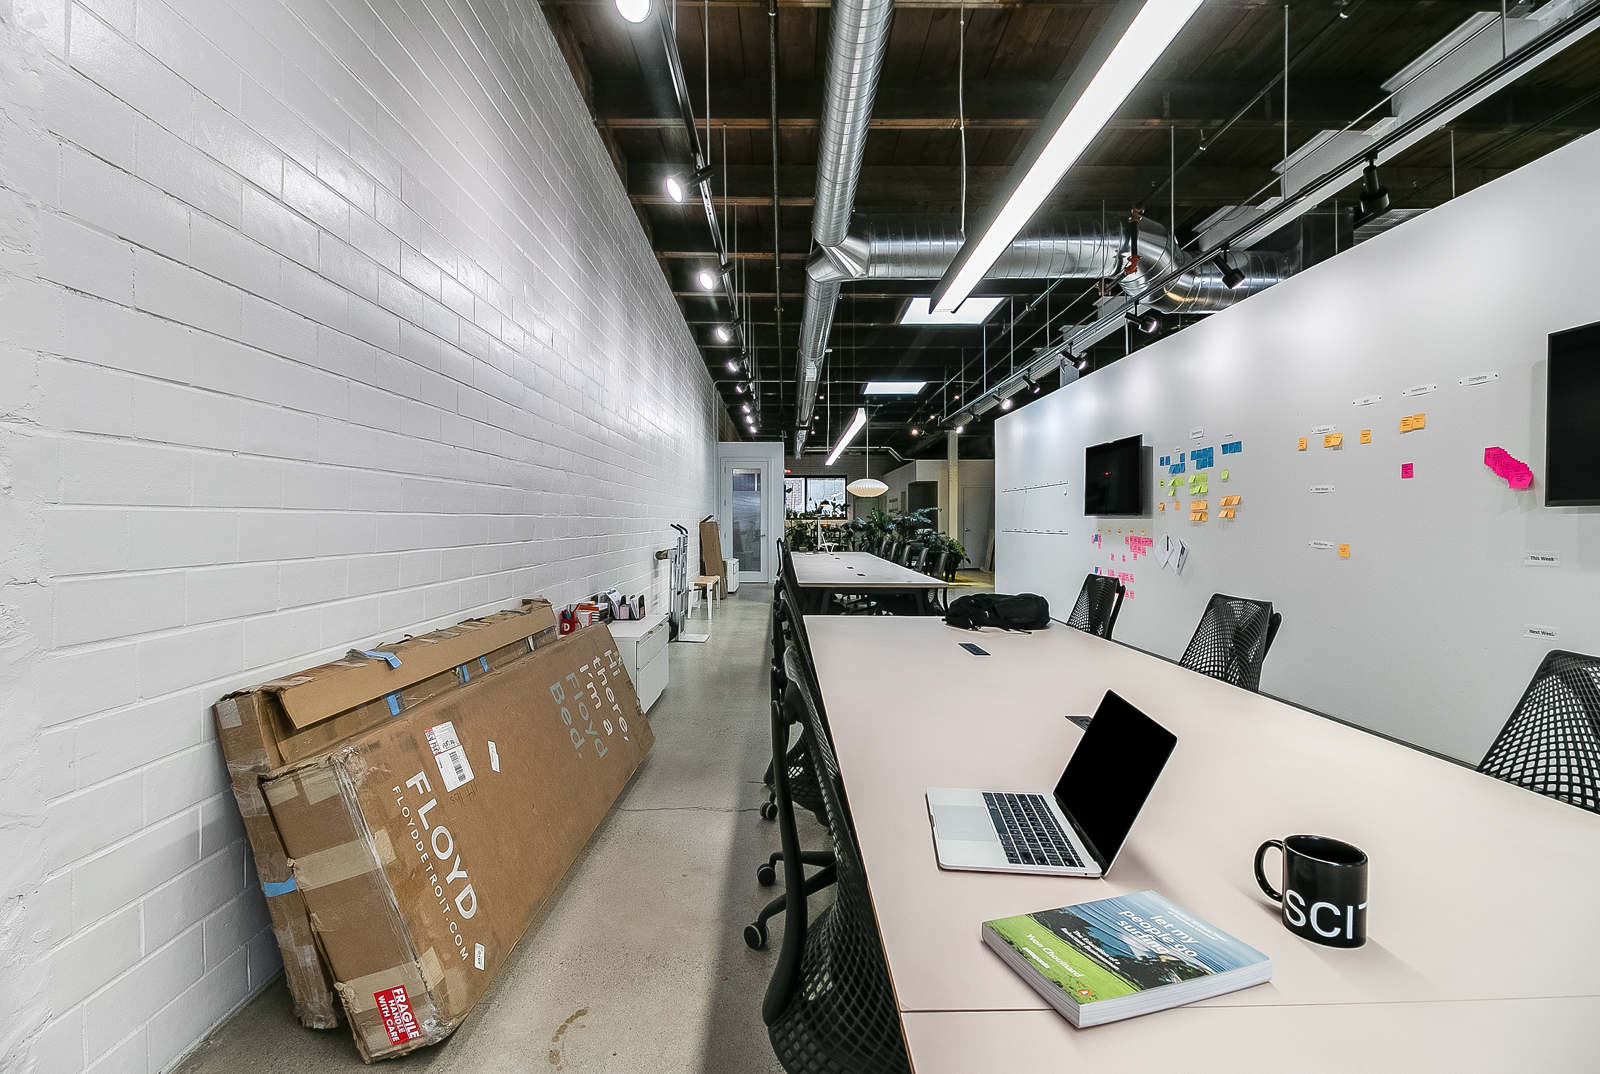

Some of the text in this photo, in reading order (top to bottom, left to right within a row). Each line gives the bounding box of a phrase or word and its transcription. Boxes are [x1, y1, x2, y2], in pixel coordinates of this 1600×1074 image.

[604, 649, 621, 677] Hi
[549, 681, 585, 759] Bed.
[566, 672, 608, 758] Floyd
[593, 656, 629, 741] there,
[603, 718, 613, 736] a
[405, 770, 478, 920] FLOYD
[392, 785, 469, 961] FLOYDDETROIT.COM
[1117, 910, 1175, 943] people
[1174, 943, 1198, 957] go
[1117, 920, 1169, 955] surfing
[1150, 915, 1174, 929] let
[1171, 929, 1200, 944] my
[1285, 889, 1368, 939] SCI
[378, 995, 400, 1042] WITH CARE
[388, 1000, 406, 1034] HANDLE
[393, 988, 420, 1039] FRAGILE
